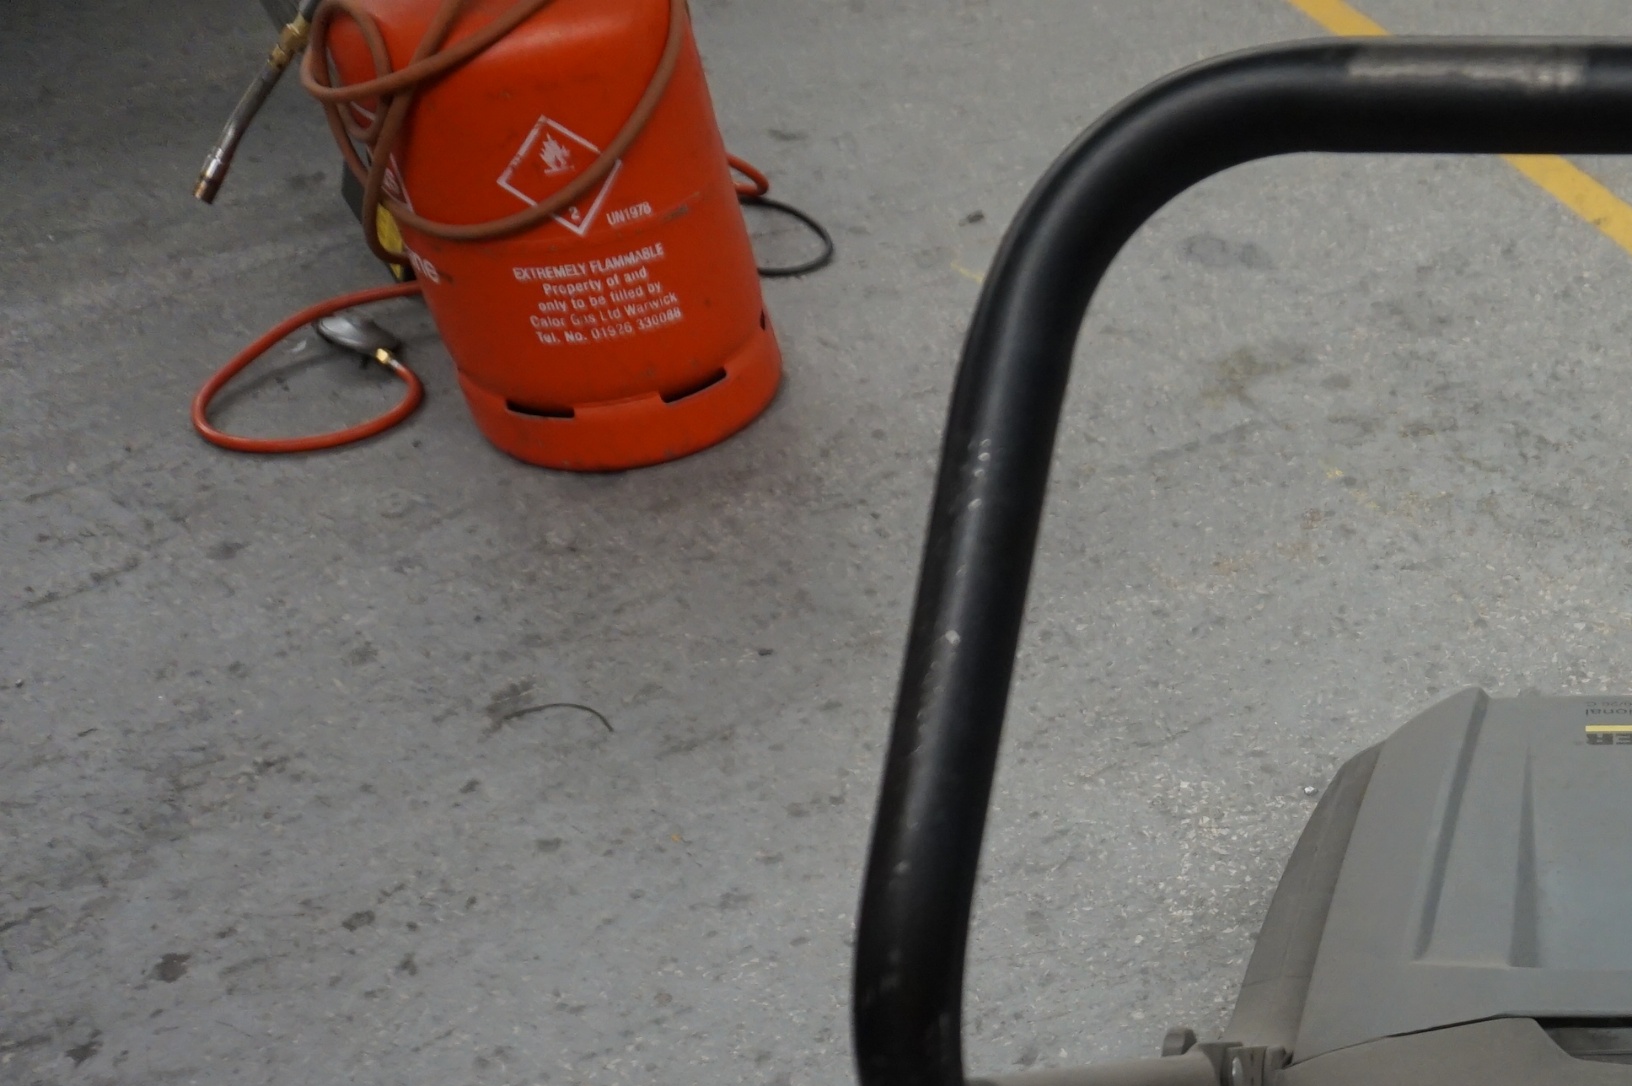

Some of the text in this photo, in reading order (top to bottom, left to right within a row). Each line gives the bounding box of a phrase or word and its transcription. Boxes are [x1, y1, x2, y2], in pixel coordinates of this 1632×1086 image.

[569, 206, 581, 220] 2
[606, 201, 652, 226] UN1978
[512, 242, 665, 281] EXTREMELY FLAMMABLE
[542, 266, 648, 296] Property of and
[529, 314, 566, 329] Calor
[601, 306, 621, 322] Ltd
[624, 292, 678, 316] Warwick
[538, 281, 663, 312] only to be filled by
[535, 330, 561, 344] Tel.
[564, 329, 588, 342] No.
